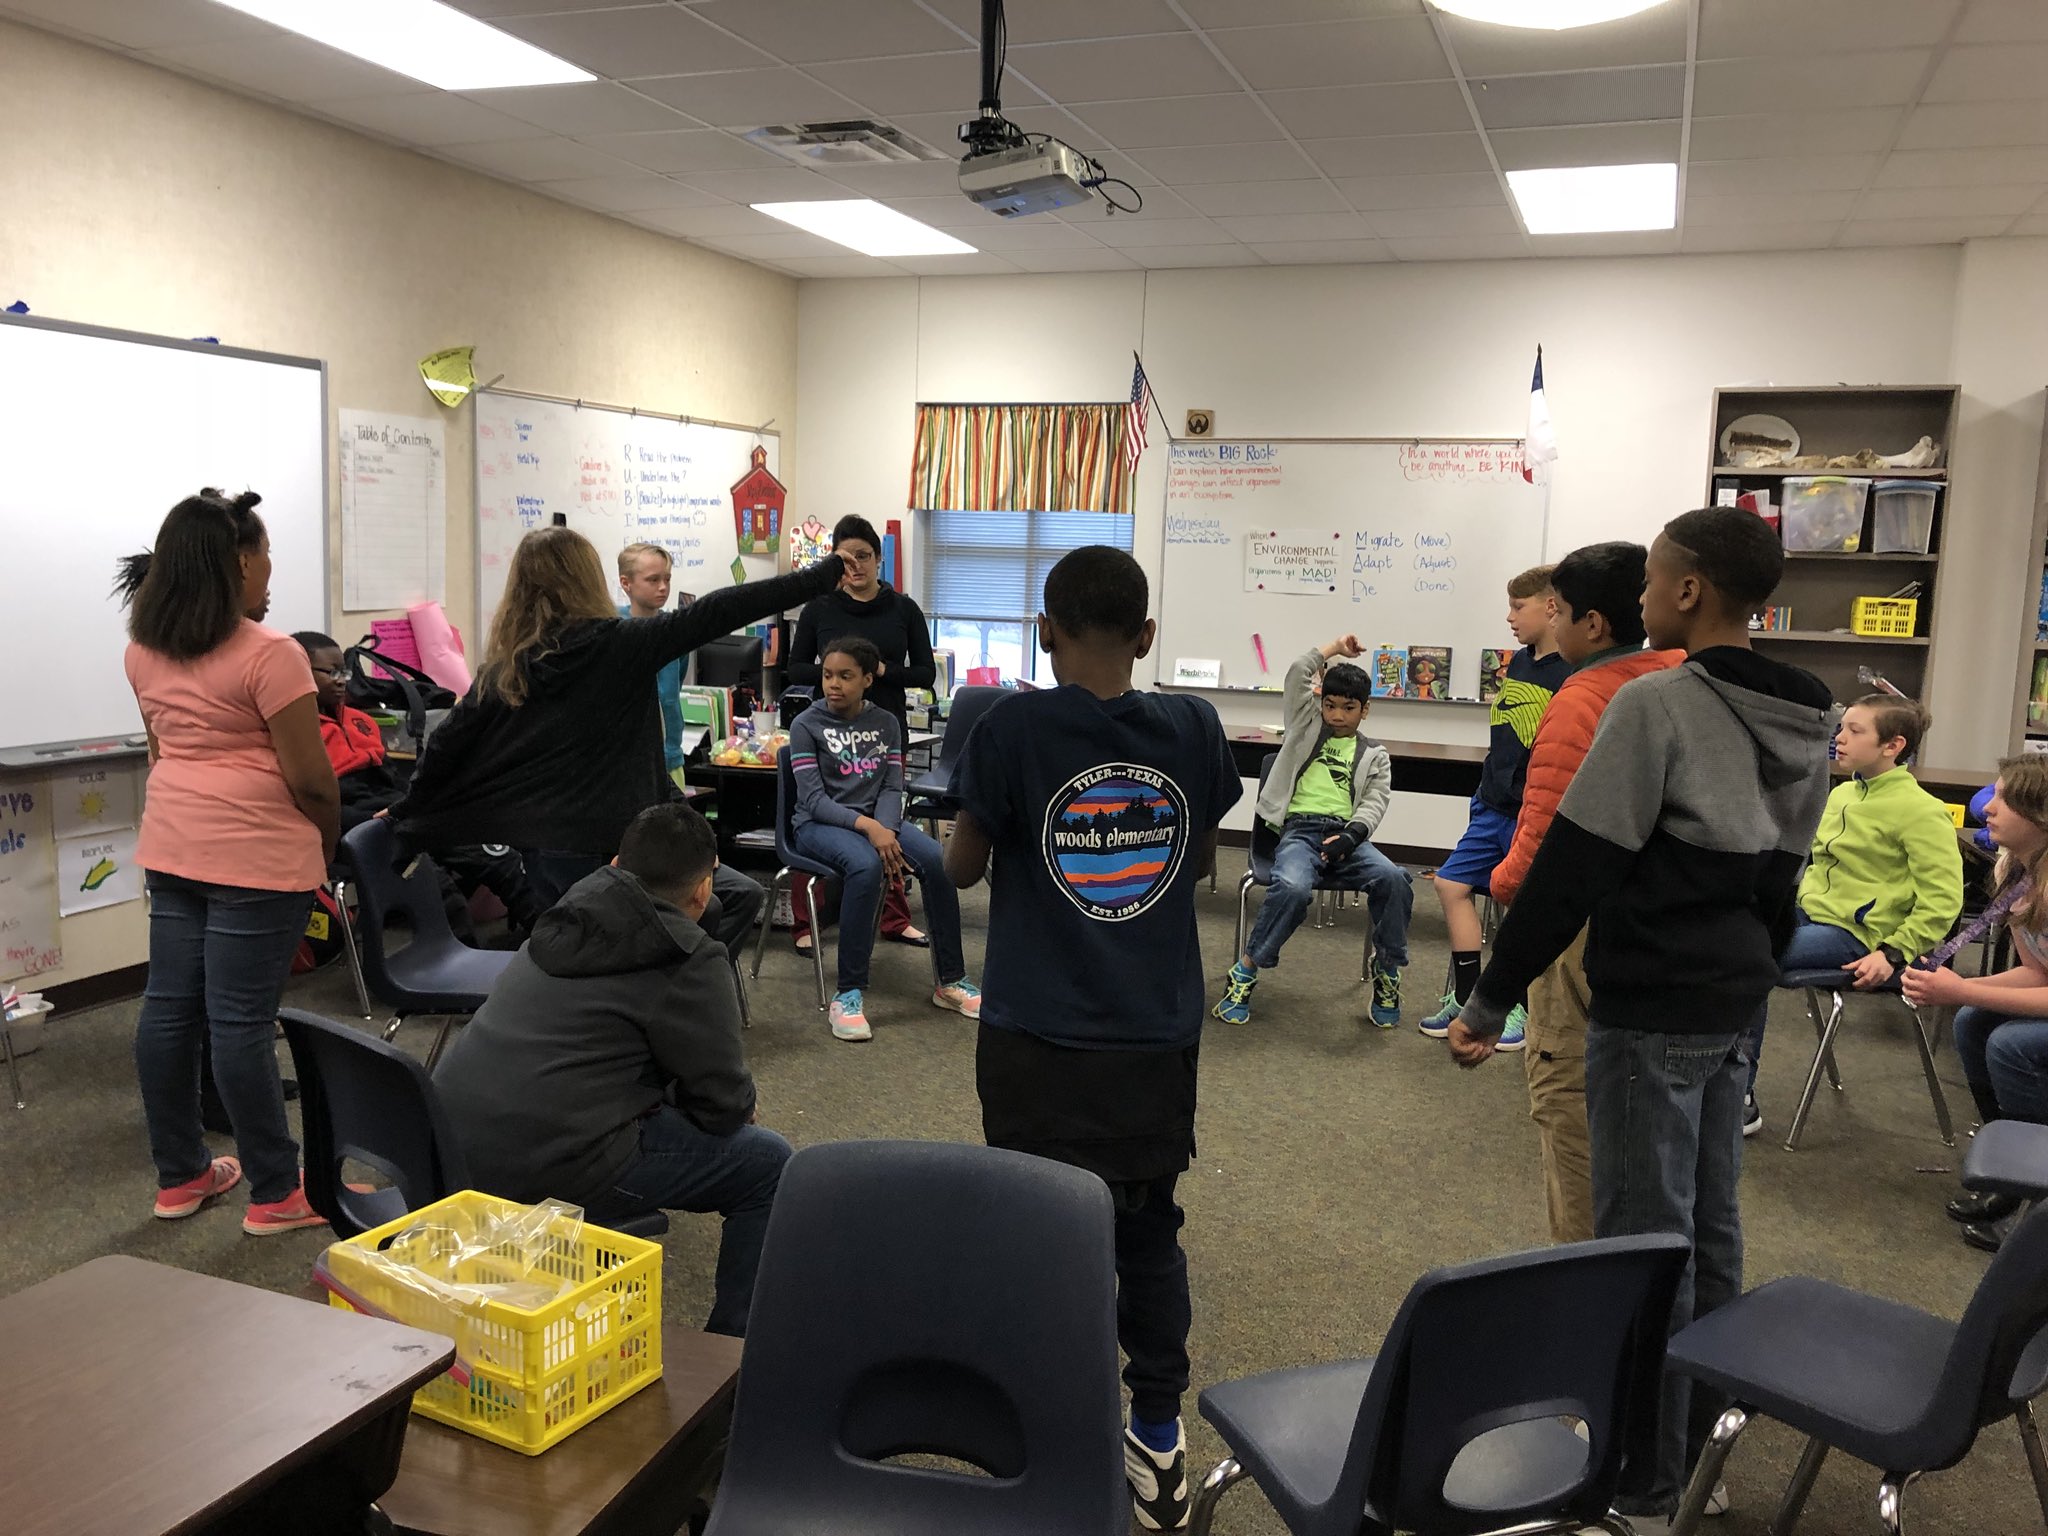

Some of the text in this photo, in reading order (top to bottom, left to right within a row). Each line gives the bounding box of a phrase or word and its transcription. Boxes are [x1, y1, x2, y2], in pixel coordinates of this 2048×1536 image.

[354, 424, 379, 442] Table
[382, 424, 390, 443] of
[624, 444, 632, 462] R
[1170, 444, 1186, 458] This
[1220, 446, 1240, 460] BIG
[1408, 447, 1418, 458] In
[1421, 450, 1426, 458] a
[1434, 446, 1459, 458] world
[1464, 447, 1490, 458] where
[1190, 466, 1216, 478] explain
[1479, 462, 1494, 472] BE
[1500, 461, 1524, 473] KIN
[624, 490, 632, 506] B
[1254, 543, 1338, 556] ENVIRONMENTAL
[1356, 531, 1404, 551] Migrate
[1414, 532, 1451, 550] (Move)
[1274, 556, 1308, 564] CHANGE
[1353, 553, 1392, 573] Adapt
[1414, 554, 1456, 573] (Adjust)
[1352, 580, 1377, 596] Die
[1414, 576, 1454, 595] (Done)
[823, 728, 879, 753] Super
[840, 750, 880, 775] Star
[1054, 828, 1102, 848] woods
[1106, 826, 1176, 848] elementary
[1090, 902, 1140, 918] EST. 1956
